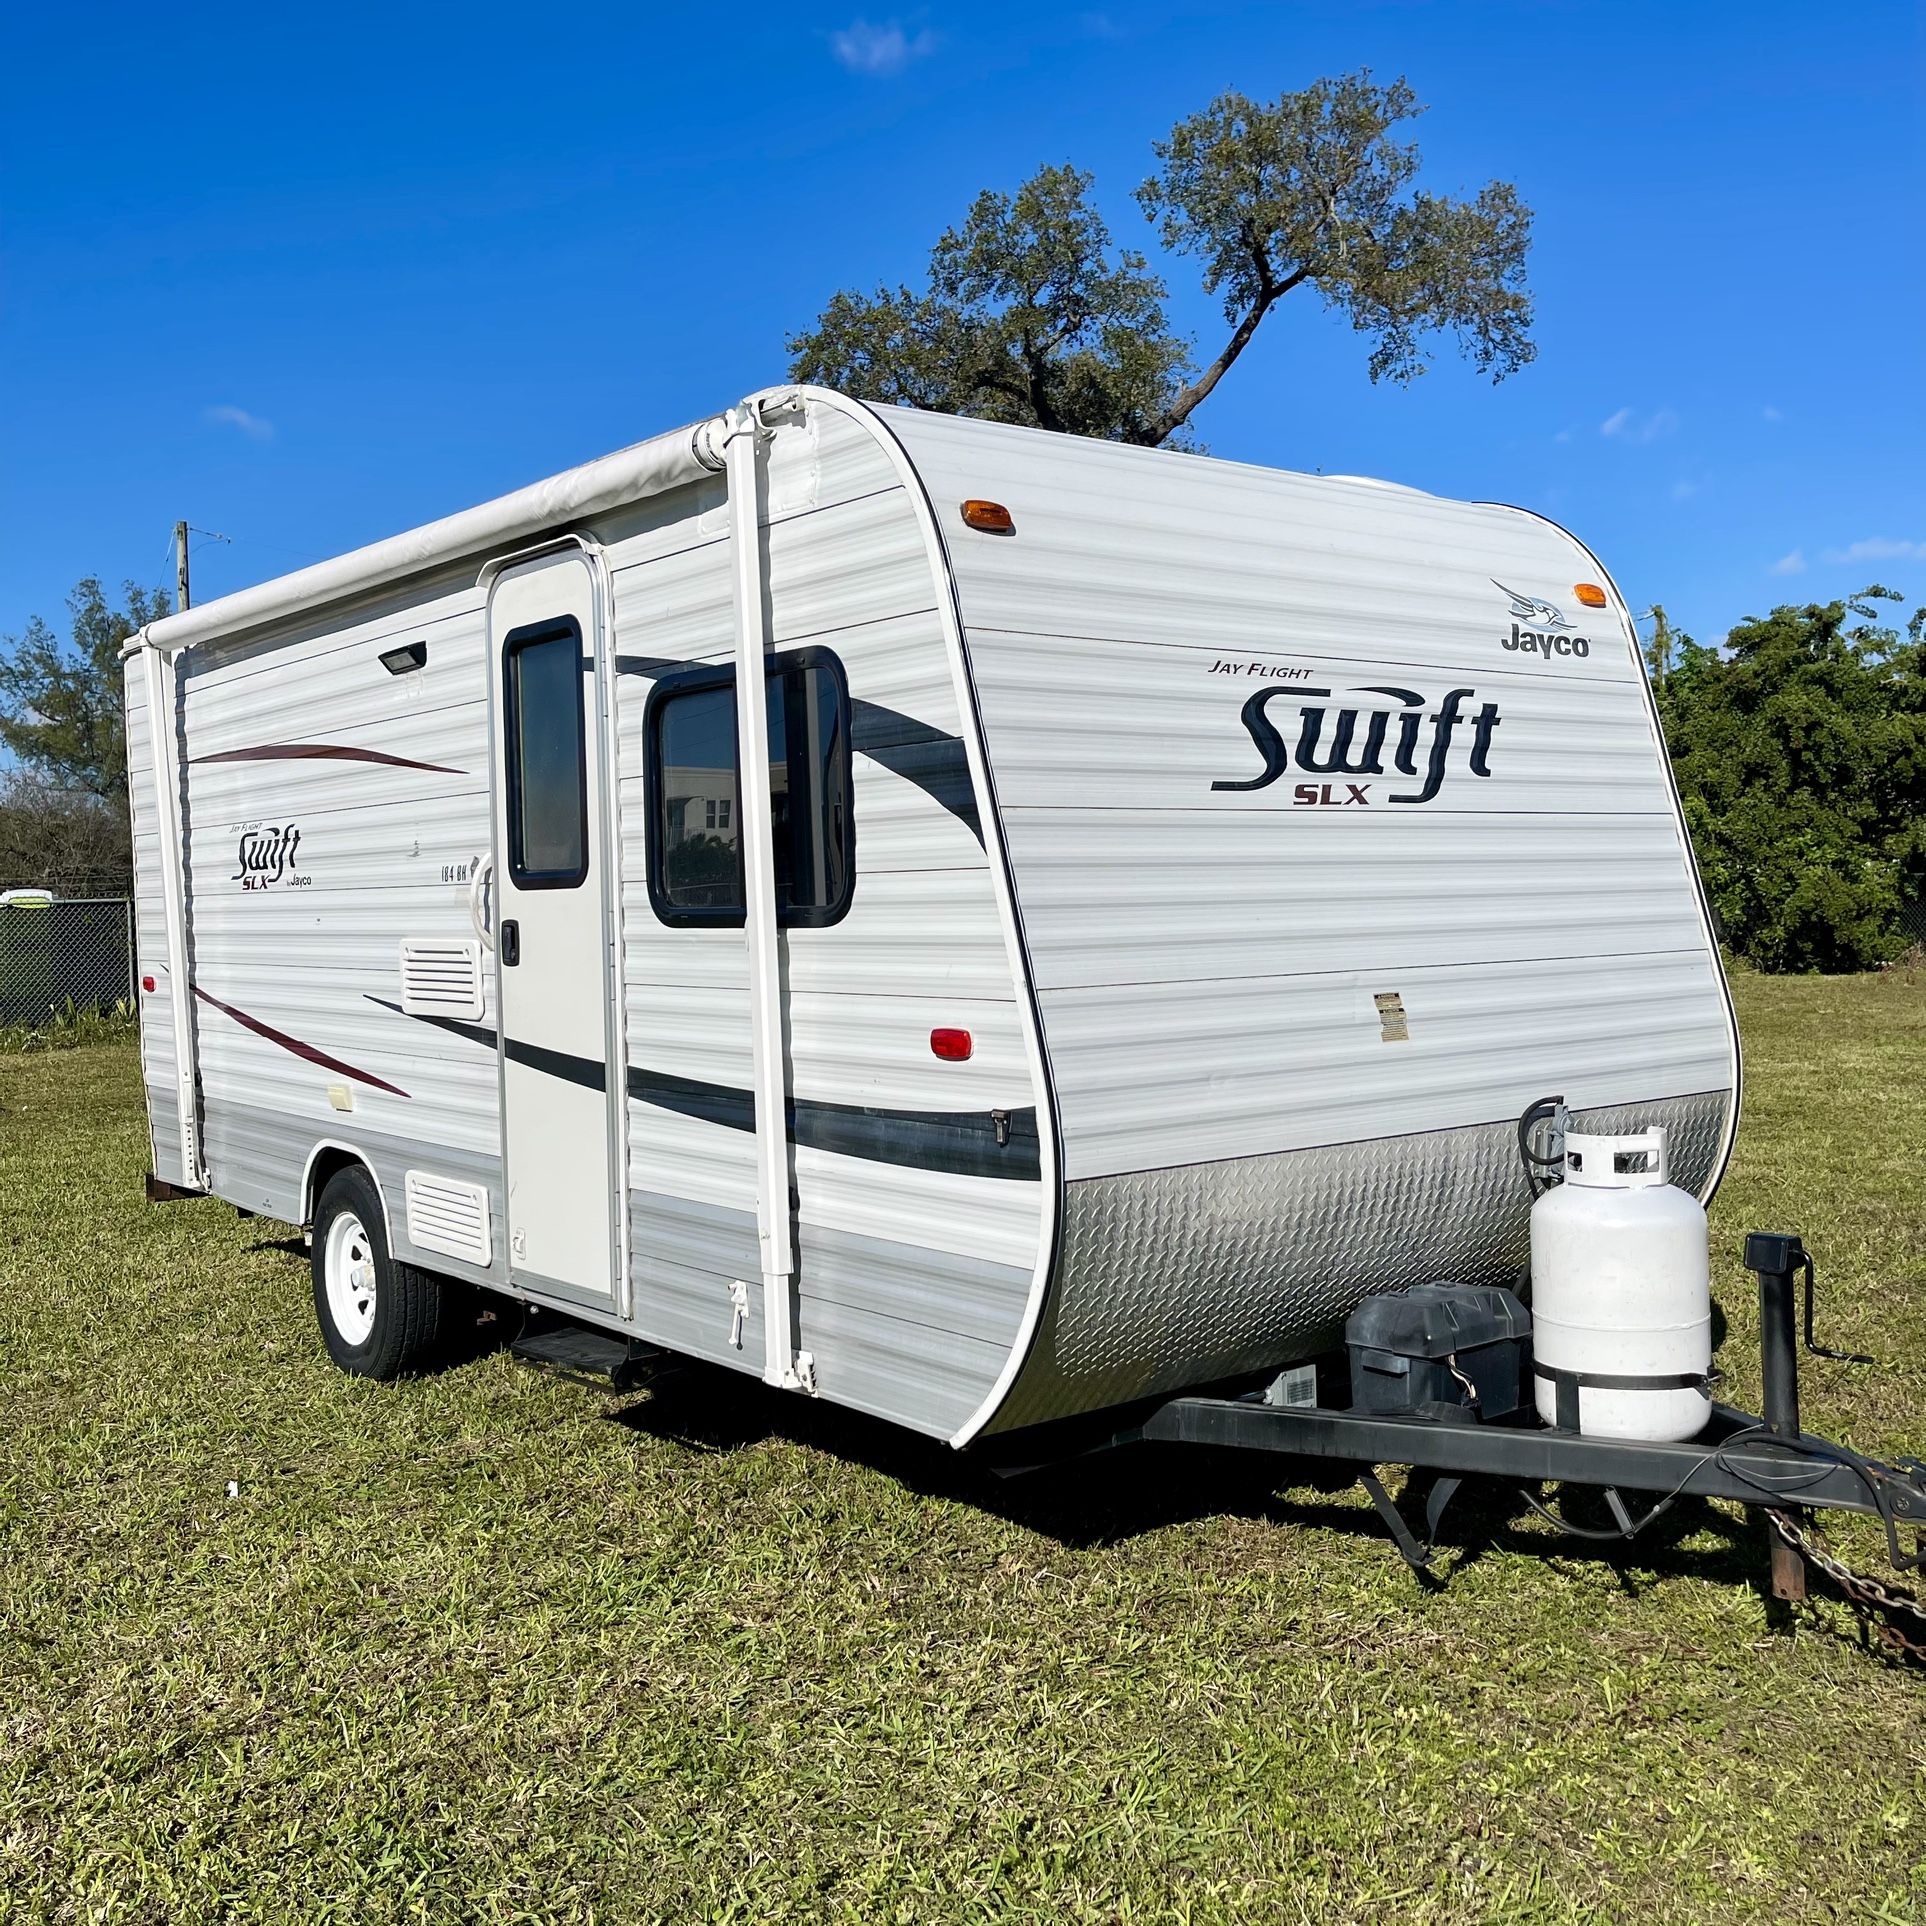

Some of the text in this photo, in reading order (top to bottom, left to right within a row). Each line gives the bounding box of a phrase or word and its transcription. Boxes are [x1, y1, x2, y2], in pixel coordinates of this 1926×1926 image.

[1501, 623, 1590, 660] Jayco
[1207, 660, 1314, 680] JAY FLIGHT
[1211, 686, 1502, 803] Swift
[1293, 784, 1371, 806] SLX
[231, 823, 301, 882] Swift
[242, 874, 270, 890] SLX
[291, 873, 312, 888] Jayco
[441, 865, 454, 882] 184
